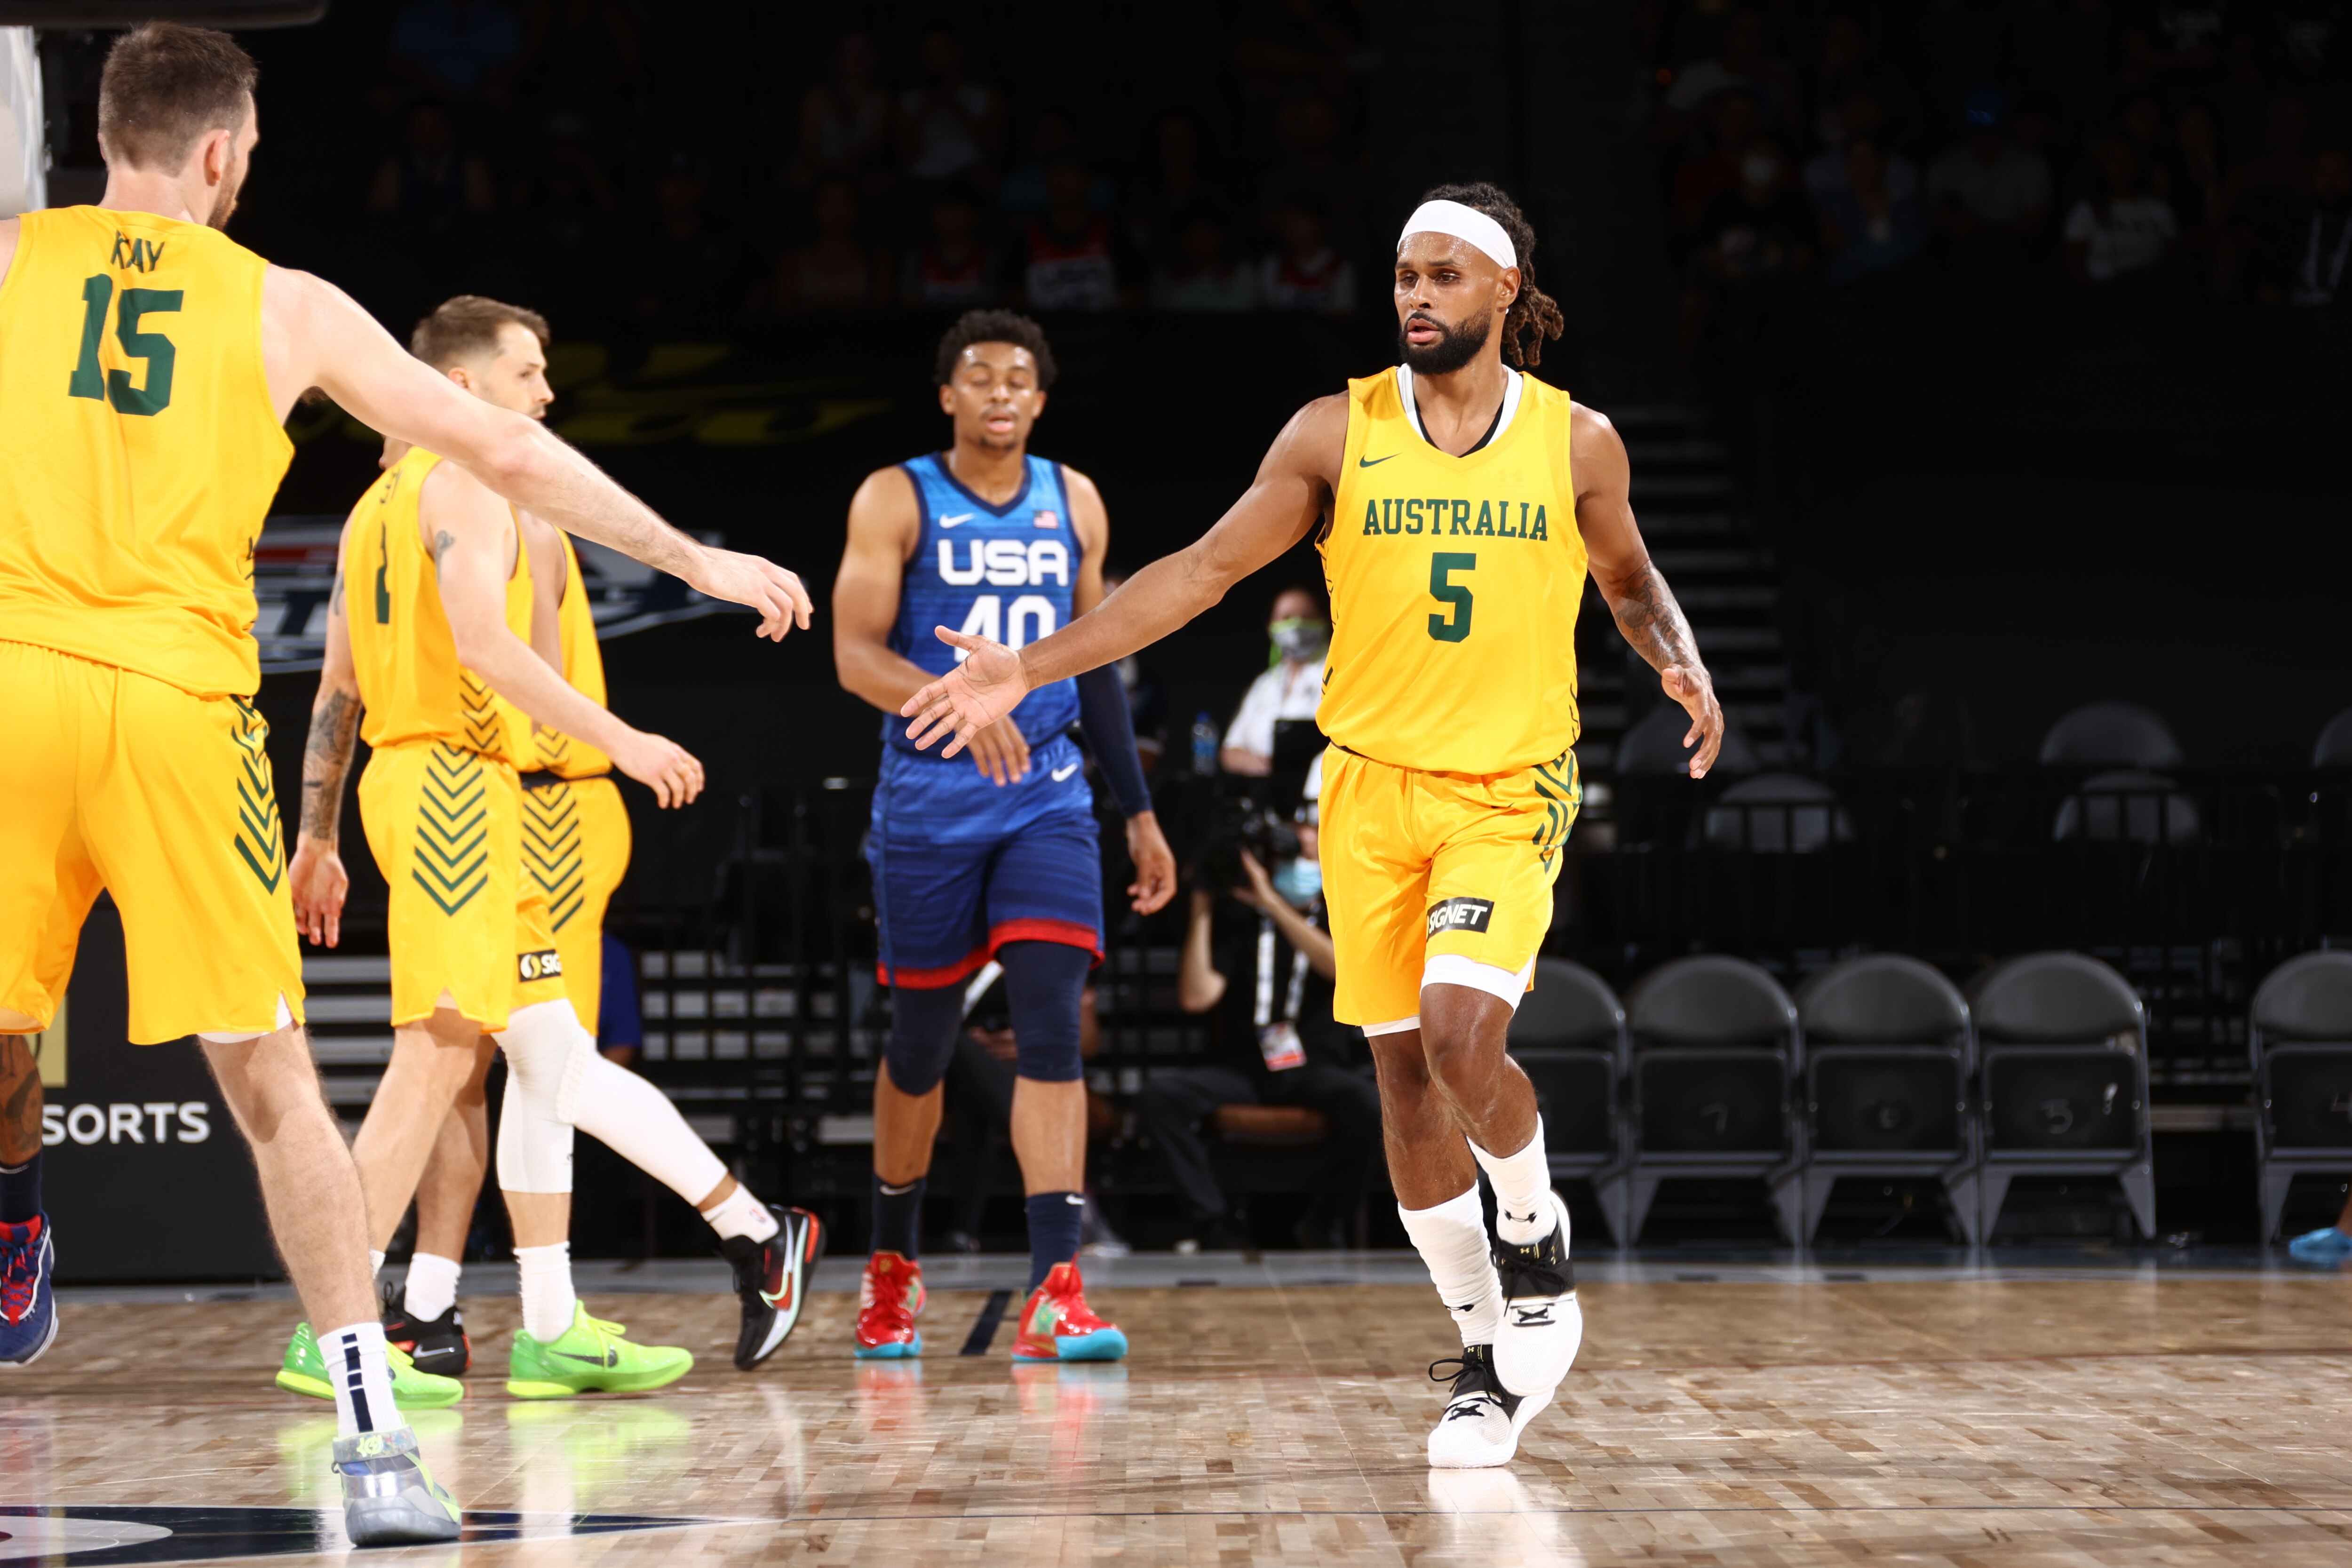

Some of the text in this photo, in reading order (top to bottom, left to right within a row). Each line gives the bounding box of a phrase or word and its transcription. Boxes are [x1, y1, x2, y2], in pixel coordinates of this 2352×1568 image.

[110, 230, 165, 273] KAY
[68, 273, 184, 416] 15
[1363, 499, 1548, 541] AUSTRALIA
[938, 539, 1068, 587] USA
[1428, 552, 1476, 643] 5
[954, 595, 1056, 663] 40
[1429, 904, 1488, 934] SIGNET
[42, 1101, 210, 1146] SORTS
